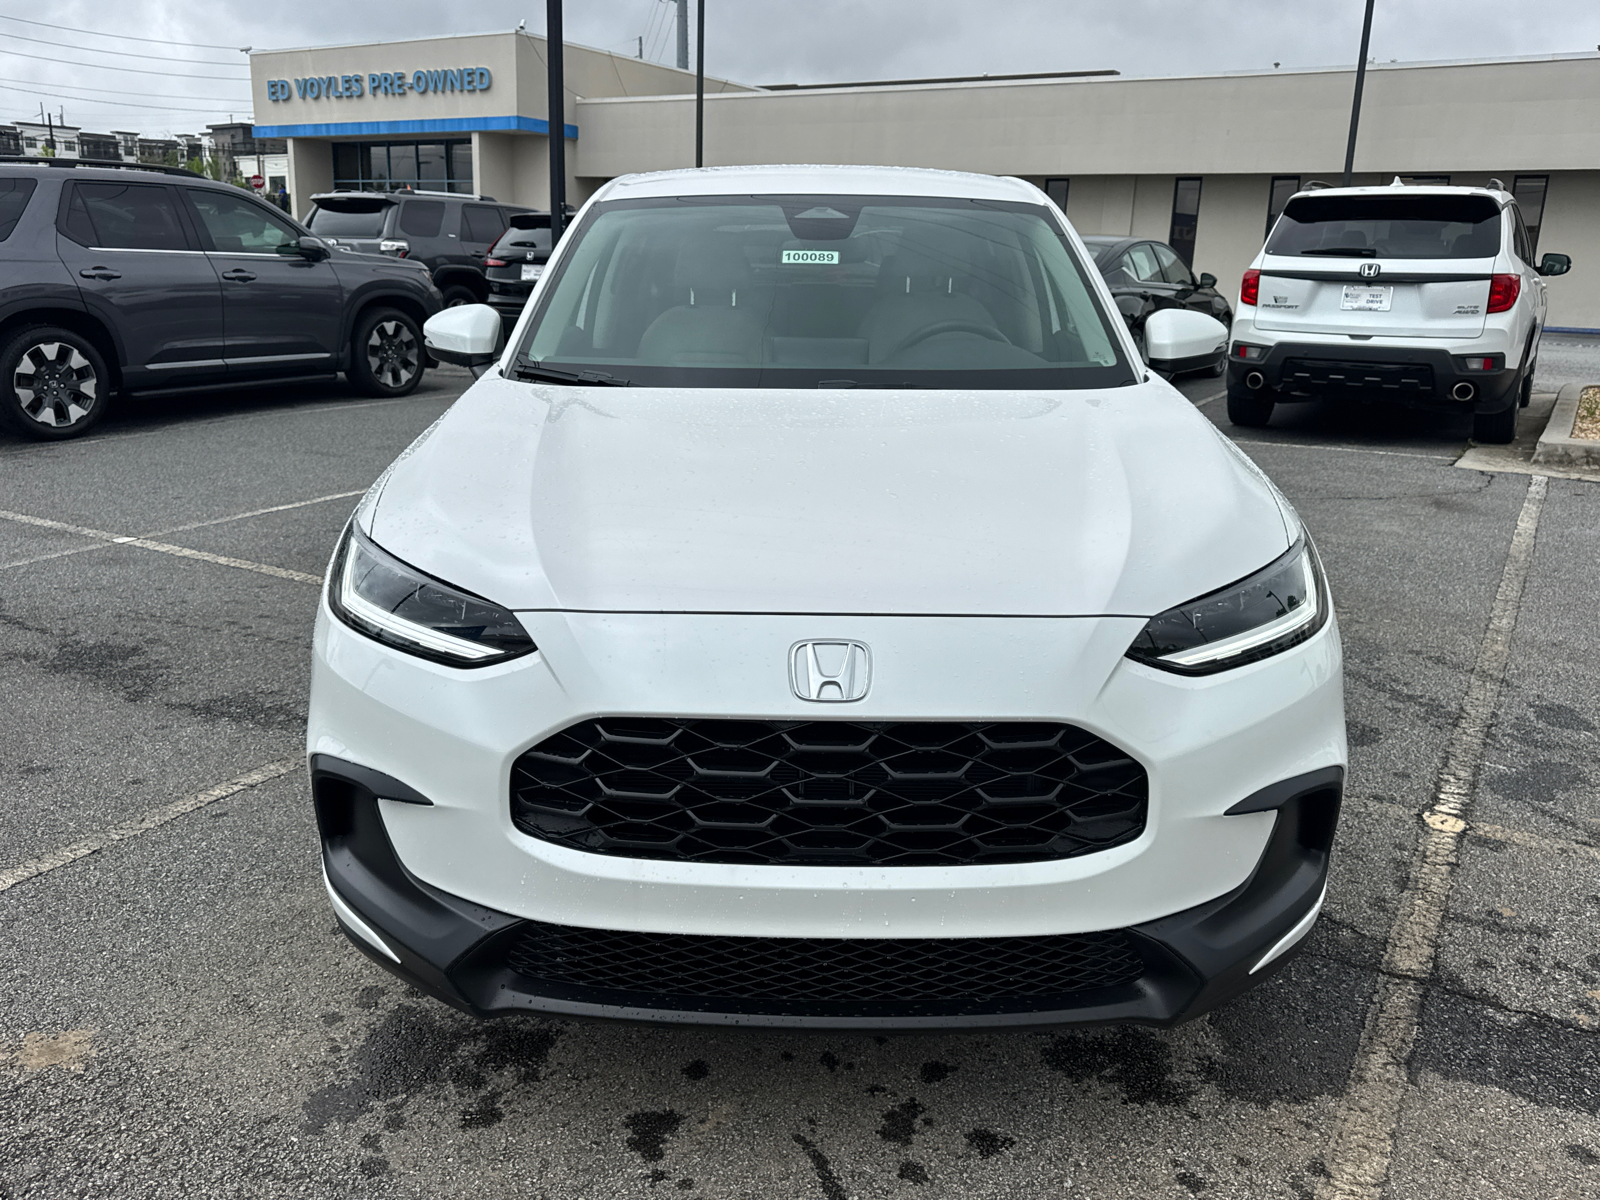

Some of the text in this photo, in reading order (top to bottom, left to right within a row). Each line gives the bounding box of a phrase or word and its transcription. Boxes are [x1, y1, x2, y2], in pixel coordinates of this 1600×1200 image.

[267, 67, 491, 101] ED VOYLES PRE-OWNED
[251, 178, 265, 186] STOP
[785, 252, 834, 262] 100089
